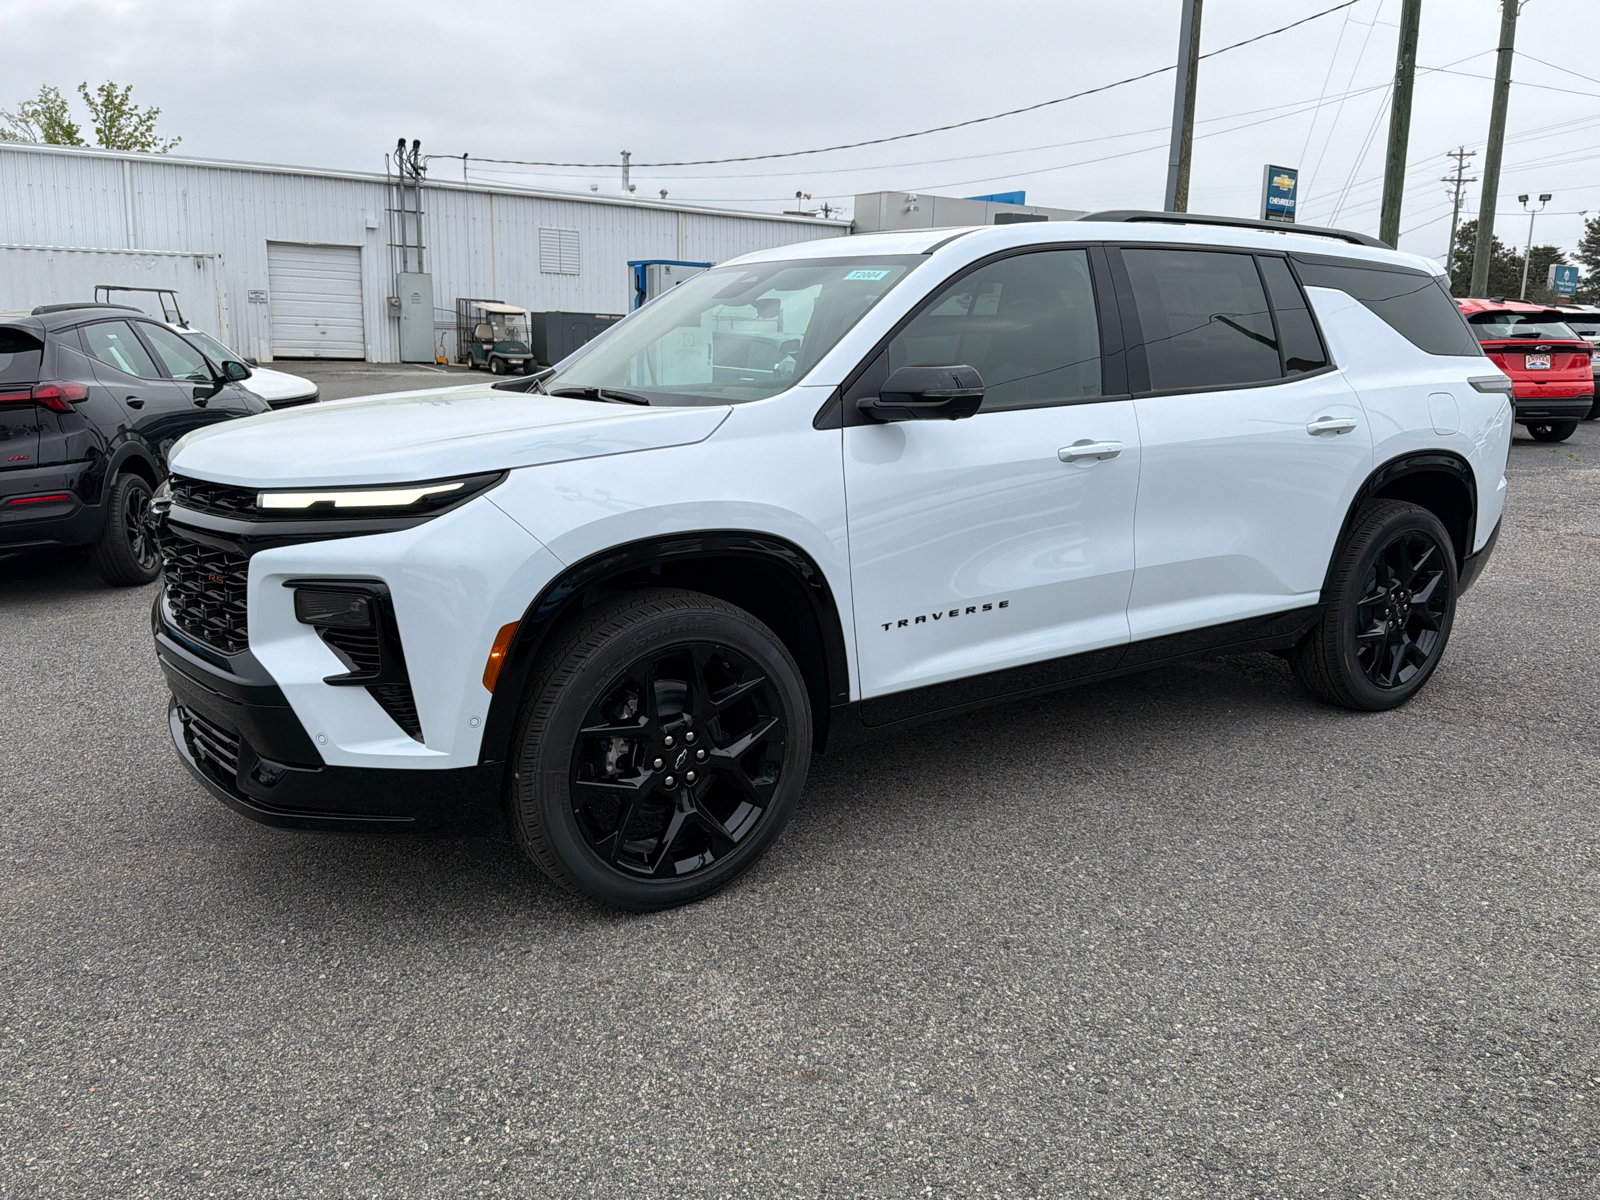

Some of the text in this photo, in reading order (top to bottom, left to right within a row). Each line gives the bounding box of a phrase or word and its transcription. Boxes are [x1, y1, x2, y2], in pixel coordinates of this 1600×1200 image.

[1269, 196, 1295, 207] CHEVROLET
[851, 271, 883, 279] T2004
[208, 573, 224, 584] RS
[881, 600, 1009, 632] TRAVERSE
